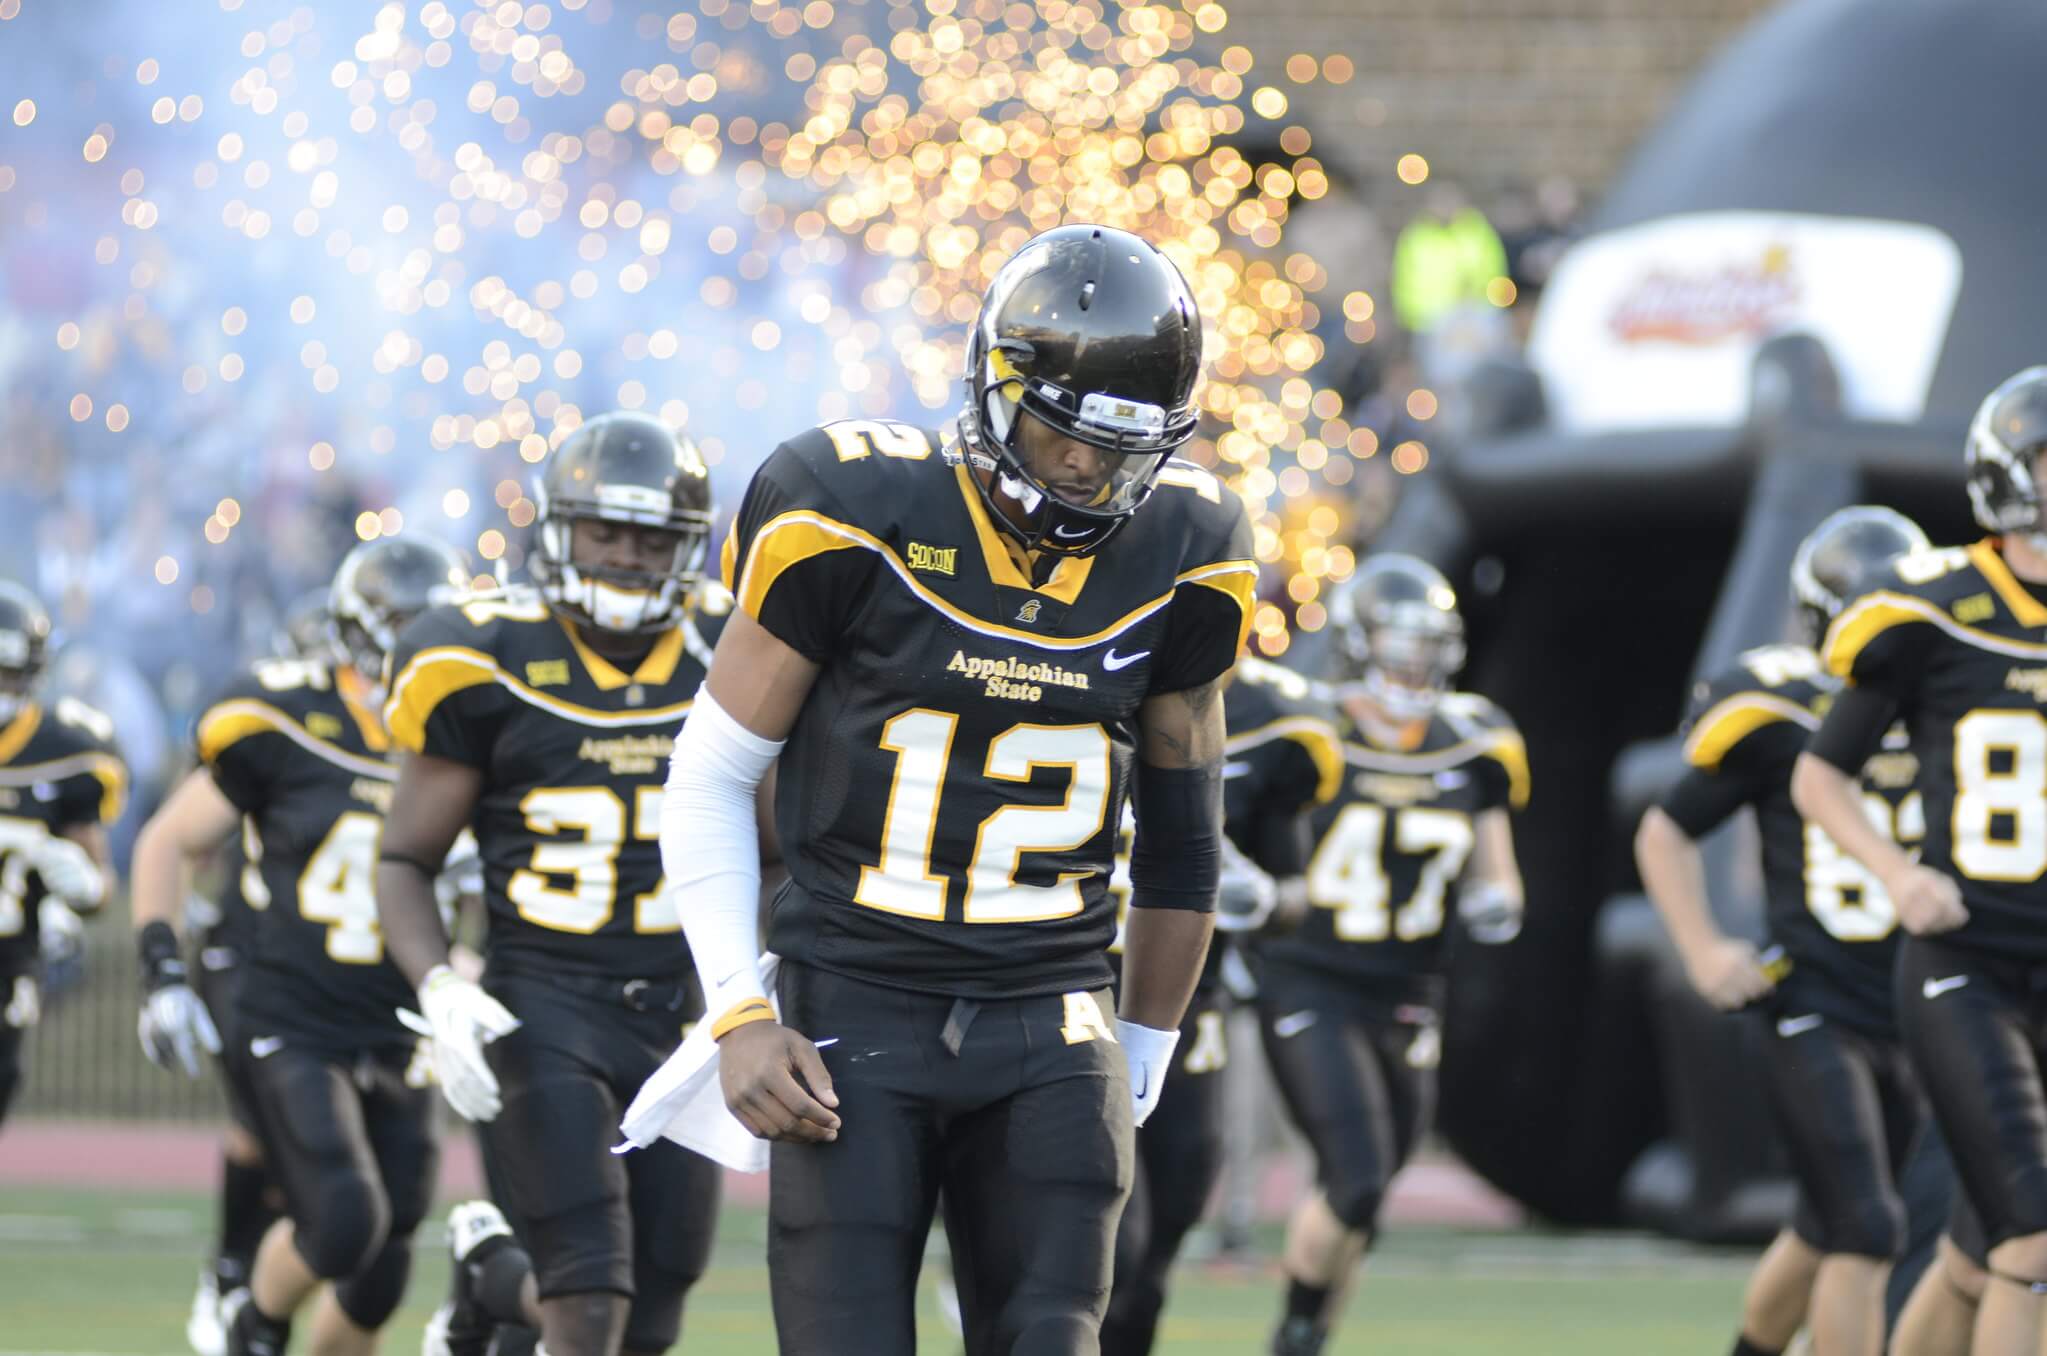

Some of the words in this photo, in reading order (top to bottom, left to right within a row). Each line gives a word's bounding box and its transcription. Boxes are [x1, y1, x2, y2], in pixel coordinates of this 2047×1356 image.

[907, 542, 958, 576] SOCON
[946, 650, 1090, 690] Appalachian
[984, 676, 1043, 702] State
[854, 707, 1111, 923] 12
[1307, 803, 1475, 942] 47
